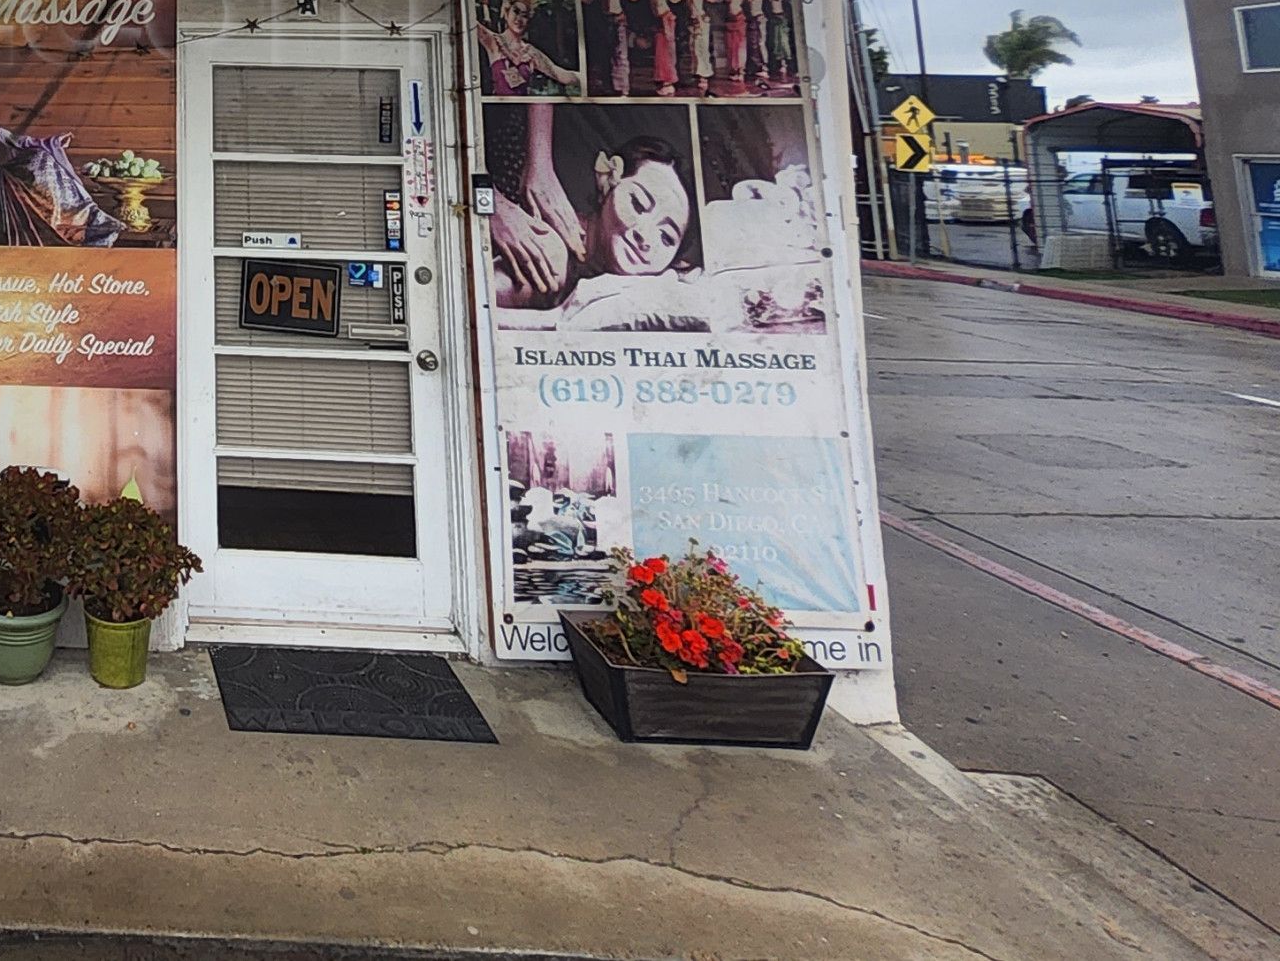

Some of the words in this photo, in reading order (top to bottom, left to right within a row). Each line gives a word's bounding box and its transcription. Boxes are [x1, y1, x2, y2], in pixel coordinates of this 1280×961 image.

[244, 235, 272, 245] Push
[48, 272, 84, 294] Hot
[87, 273, 150, 296] Stone,
[249, 272, 336, 321] OPEN
[392, 271, 404, 320] PUSH
[27, 302, 80, 334] Style
[20, 331, 73, 365] Daily
[76, 333, 155, 361] Special
[624, 348, 687, 368] THAI
[695, 348, 817, 371] MASSAGE
[538, 373, 625, 409] (619)
[636, 378, 797, 407] 888-0279
[500, 624, 568, 652] Welc
[857, 635, 882, 662] in
